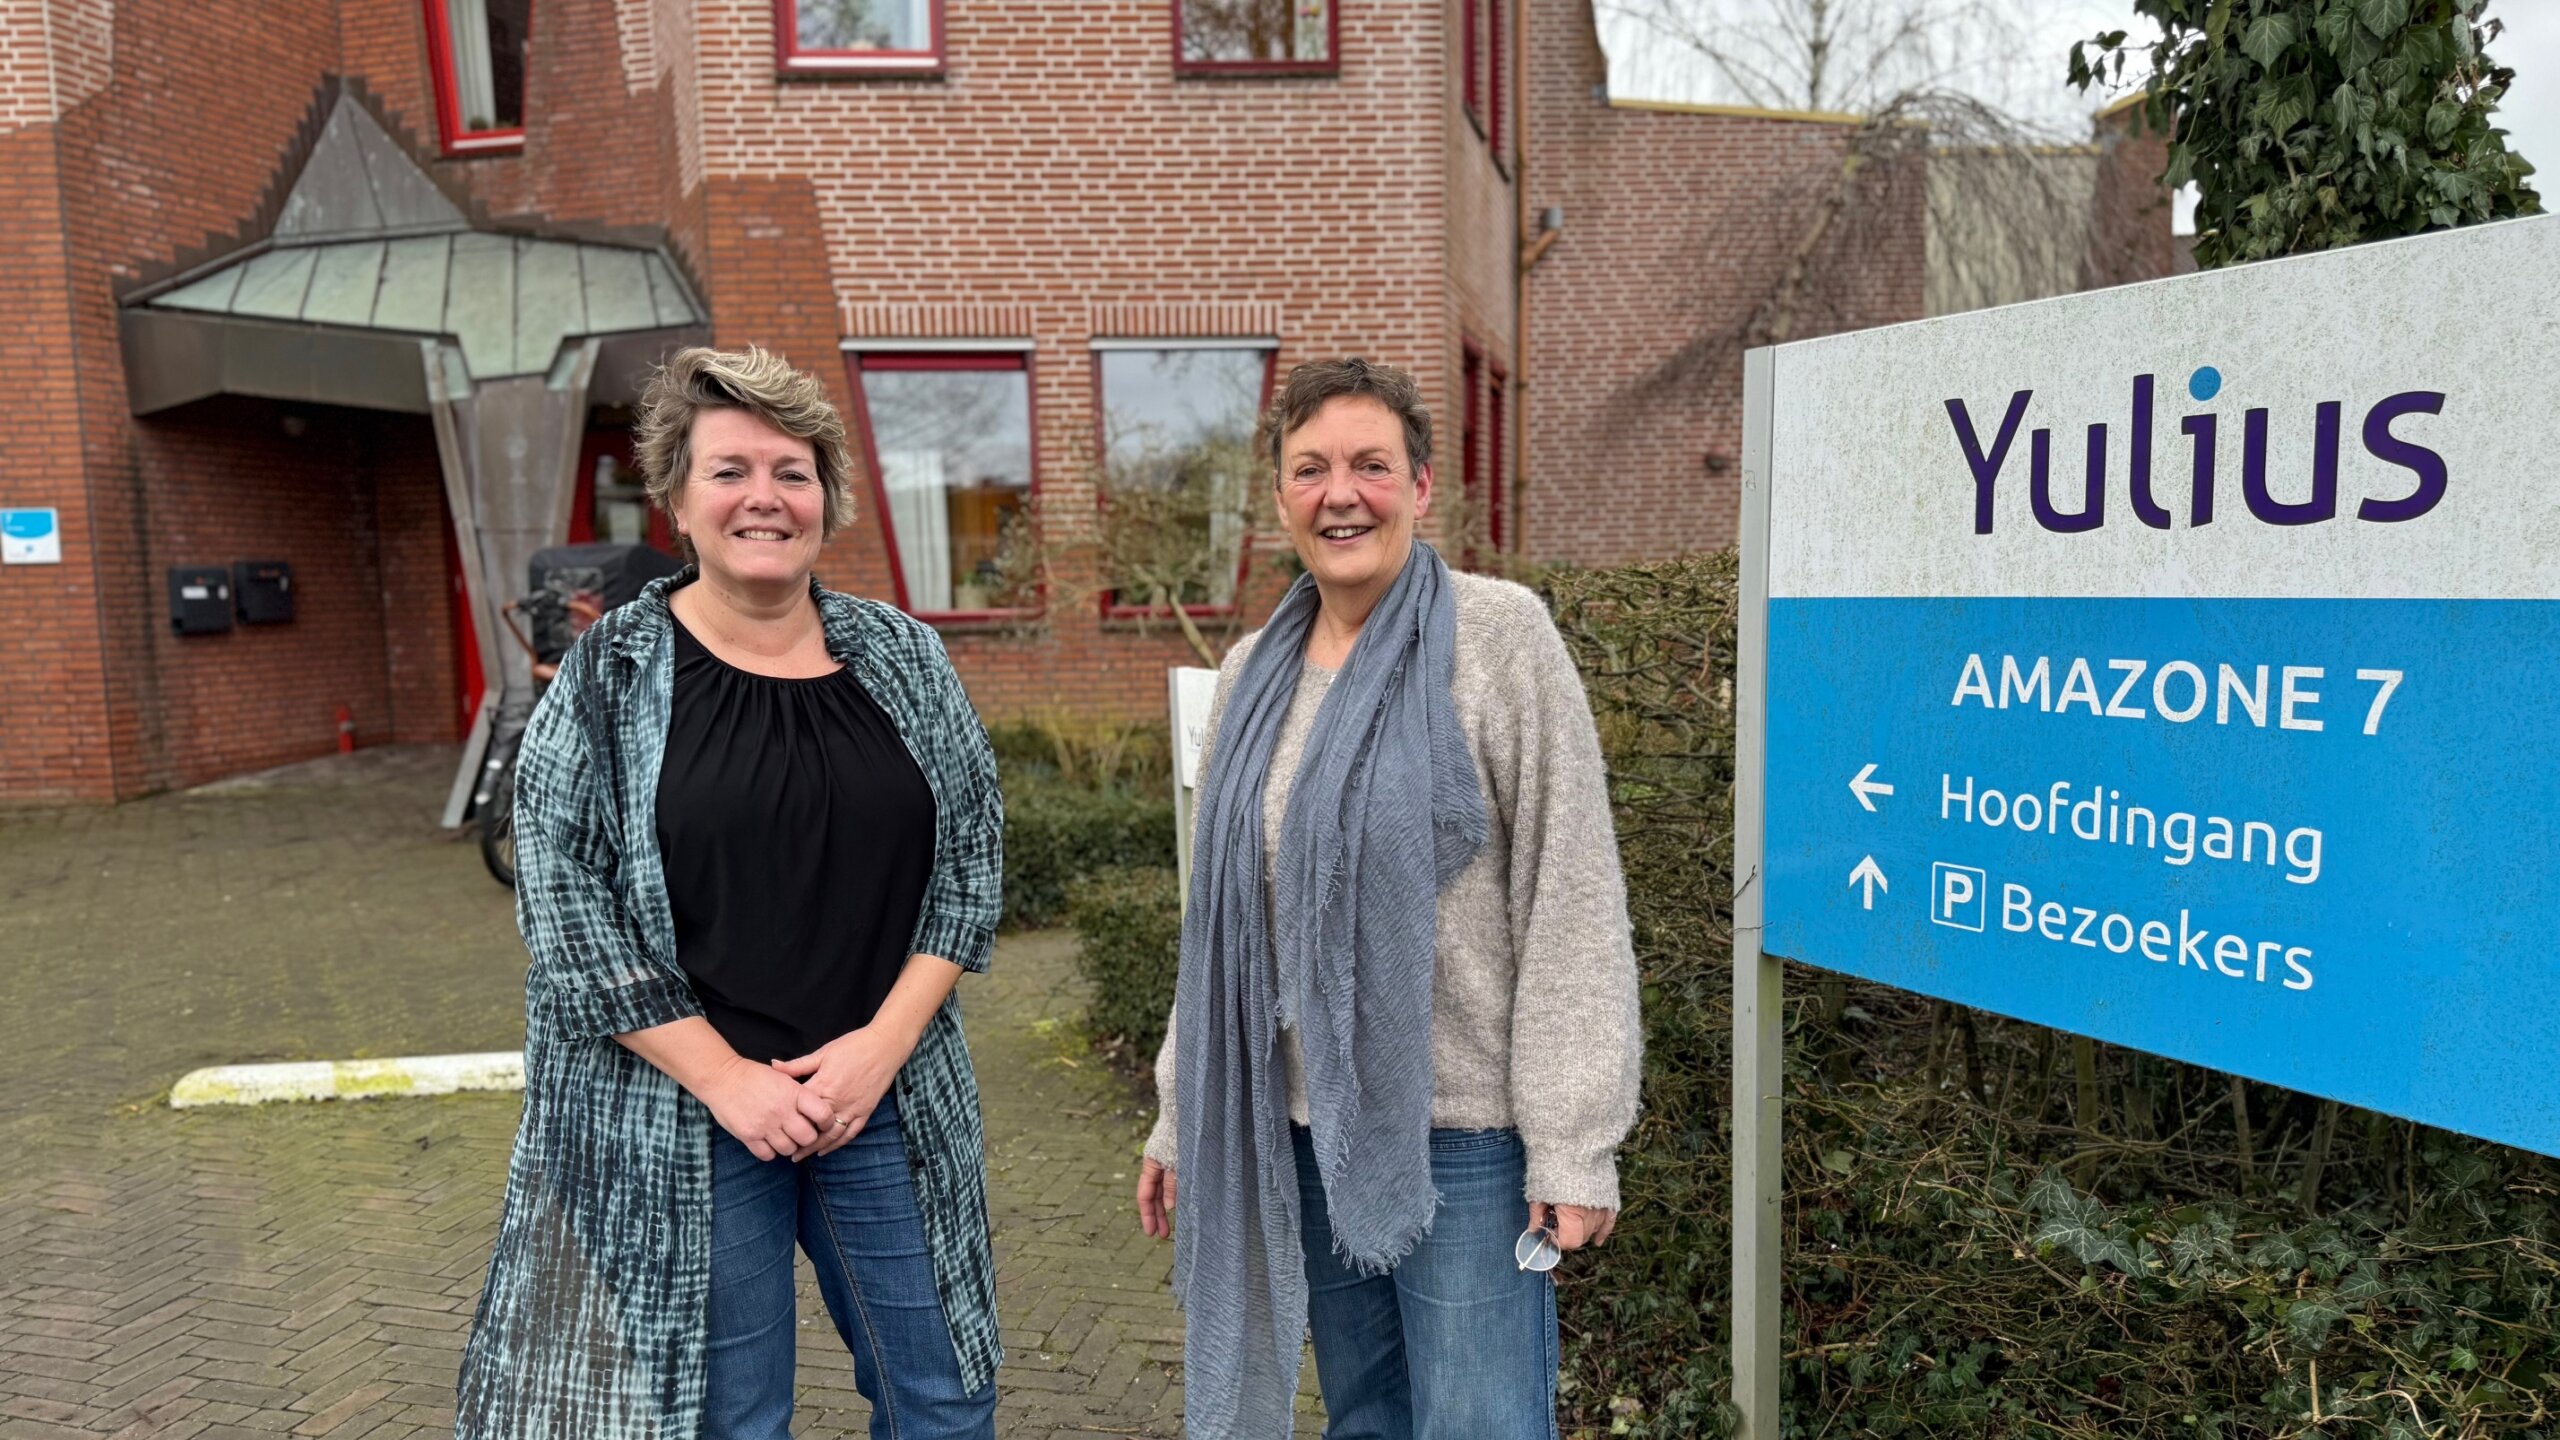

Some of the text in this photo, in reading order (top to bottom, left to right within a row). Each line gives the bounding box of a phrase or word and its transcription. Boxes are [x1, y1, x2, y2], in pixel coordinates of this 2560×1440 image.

[1944, 366, 2448, 535] Yulius
[1951, 653, 2404, 736] AMAZONE 7
[1941, 773, 2323, 884] Hoofdingang
[1943, 871, 2313, 991] P Bezoekers
